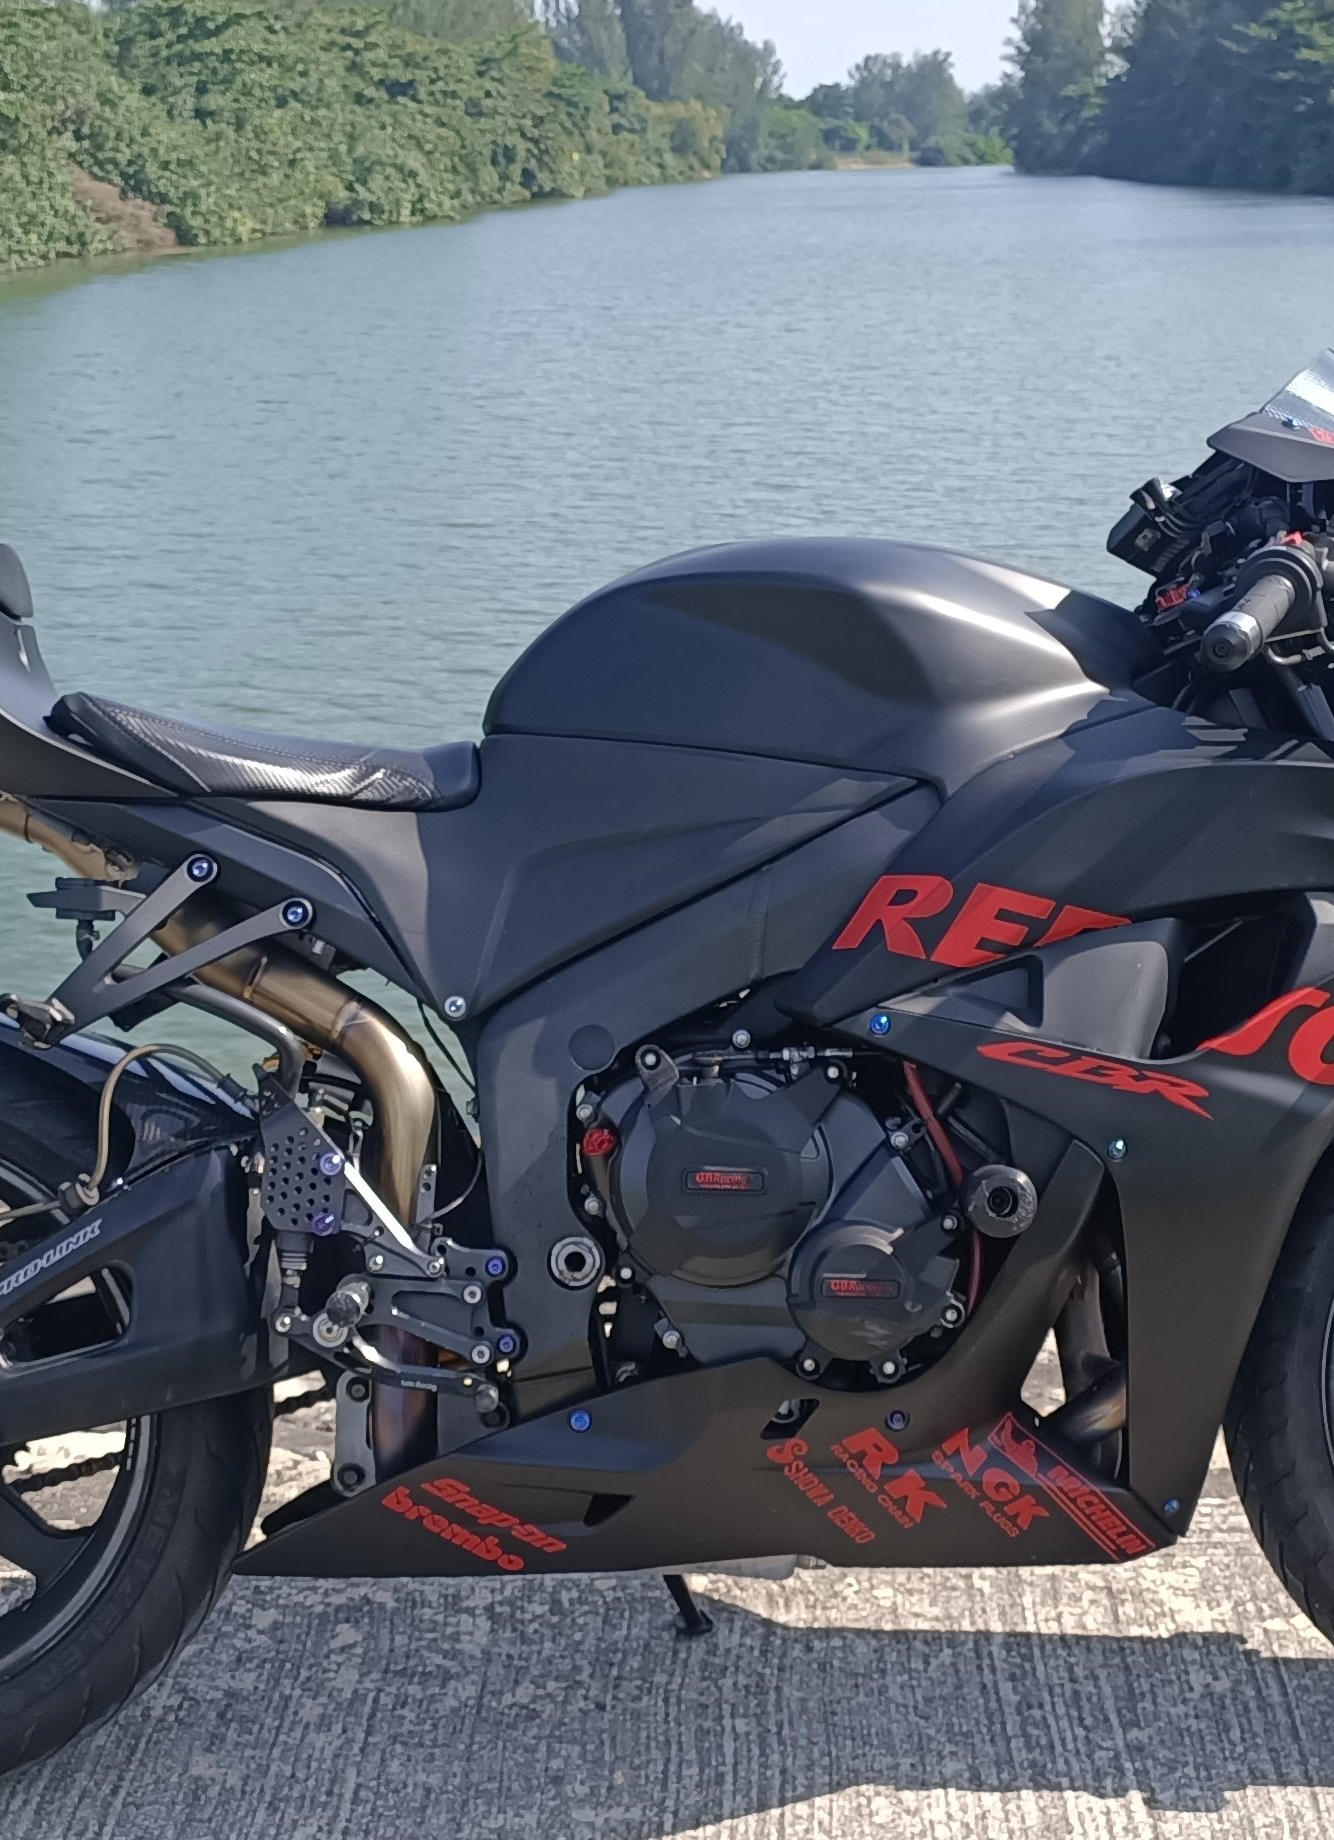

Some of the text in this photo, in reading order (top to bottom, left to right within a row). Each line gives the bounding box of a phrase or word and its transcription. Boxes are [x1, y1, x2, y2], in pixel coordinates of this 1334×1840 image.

[976, 1041, 1214, 1121] CBR
[784, 1460, 835, 1507] SHOWA
[830, 1443, 879, 1494] RACING
[841, 1426, 948, 1524] RK
[931, 1450, 981, 1499] SPARK
[941, 1427, 1050, 1531] NGK
[381, 1485, 525, 1571] brembo
[420, 1477, 568, 1554] Snap-on
[1046, 1464, 1147, 1556] MICHELIN
